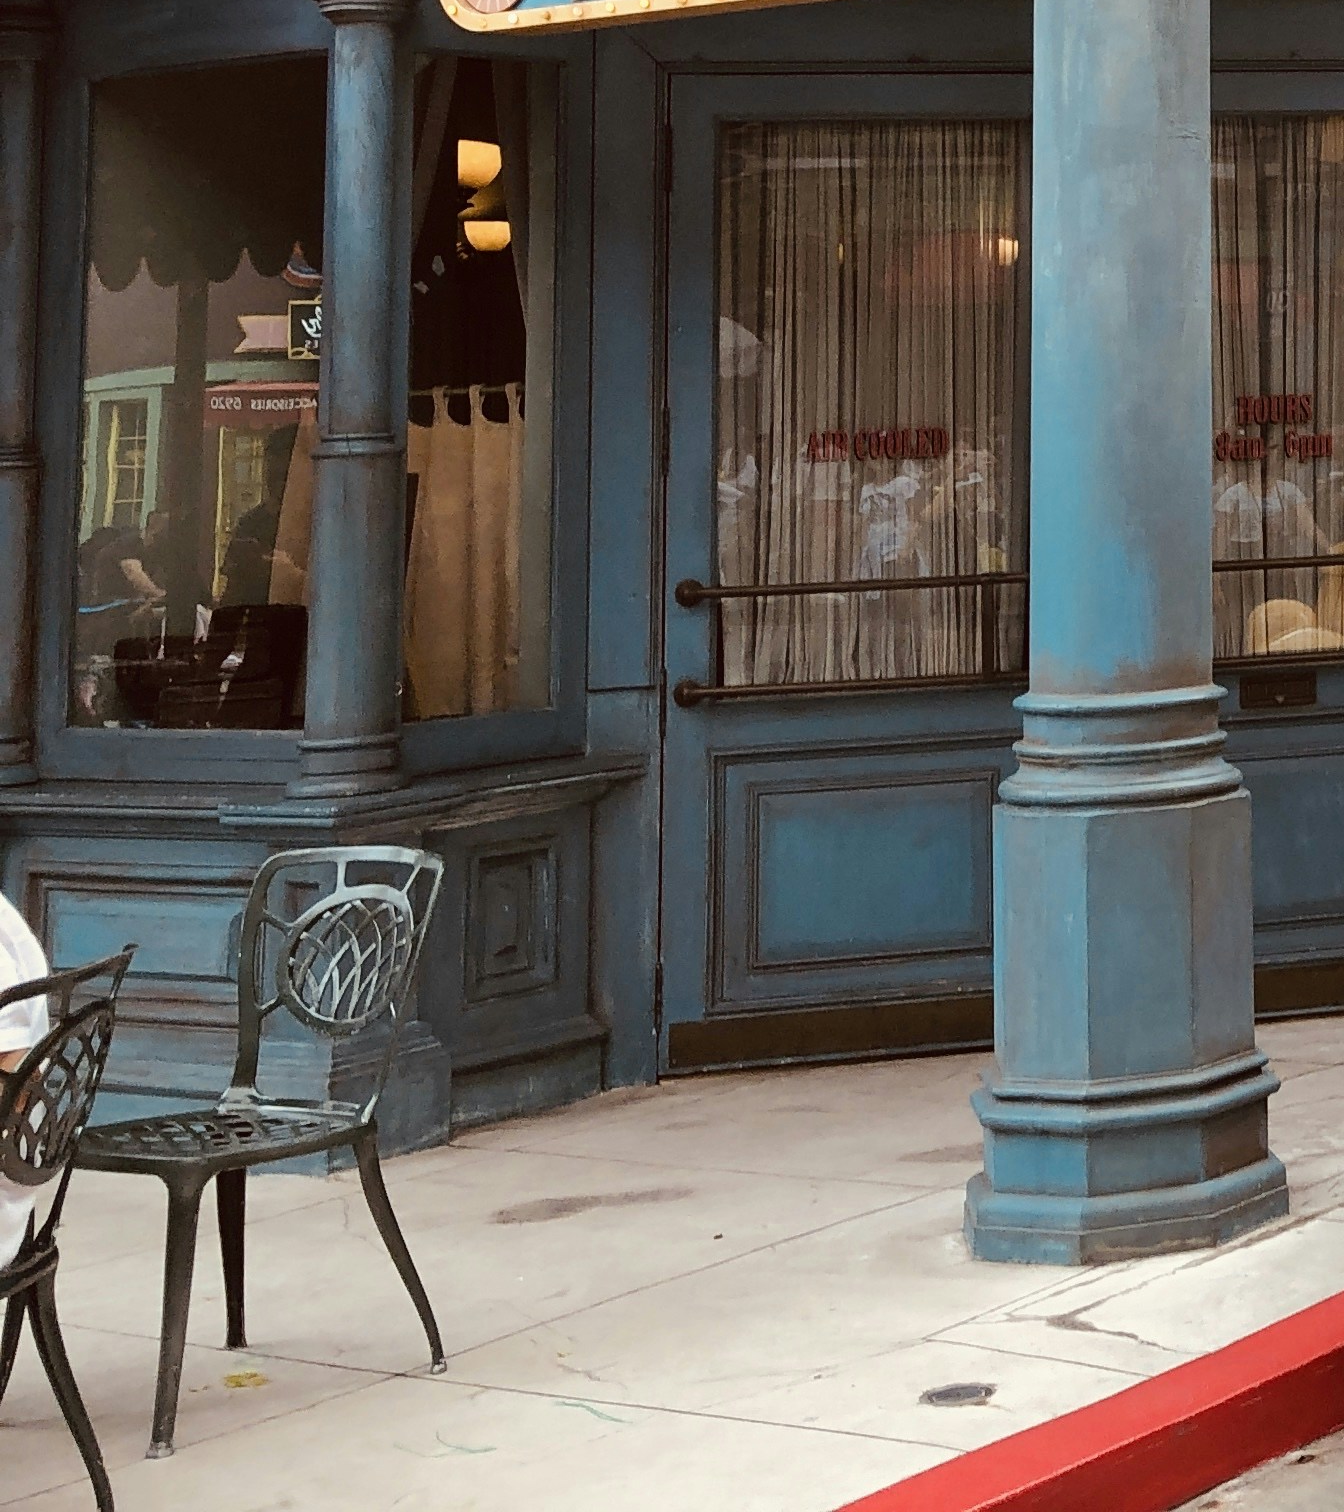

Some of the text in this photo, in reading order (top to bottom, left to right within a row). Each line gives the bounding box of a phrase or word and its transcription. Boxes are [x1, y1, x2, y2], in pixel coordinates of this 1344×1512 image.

[1236, 393, 1313, 425] HOURS
[806, 425, 950, 464] AIR COOLED
